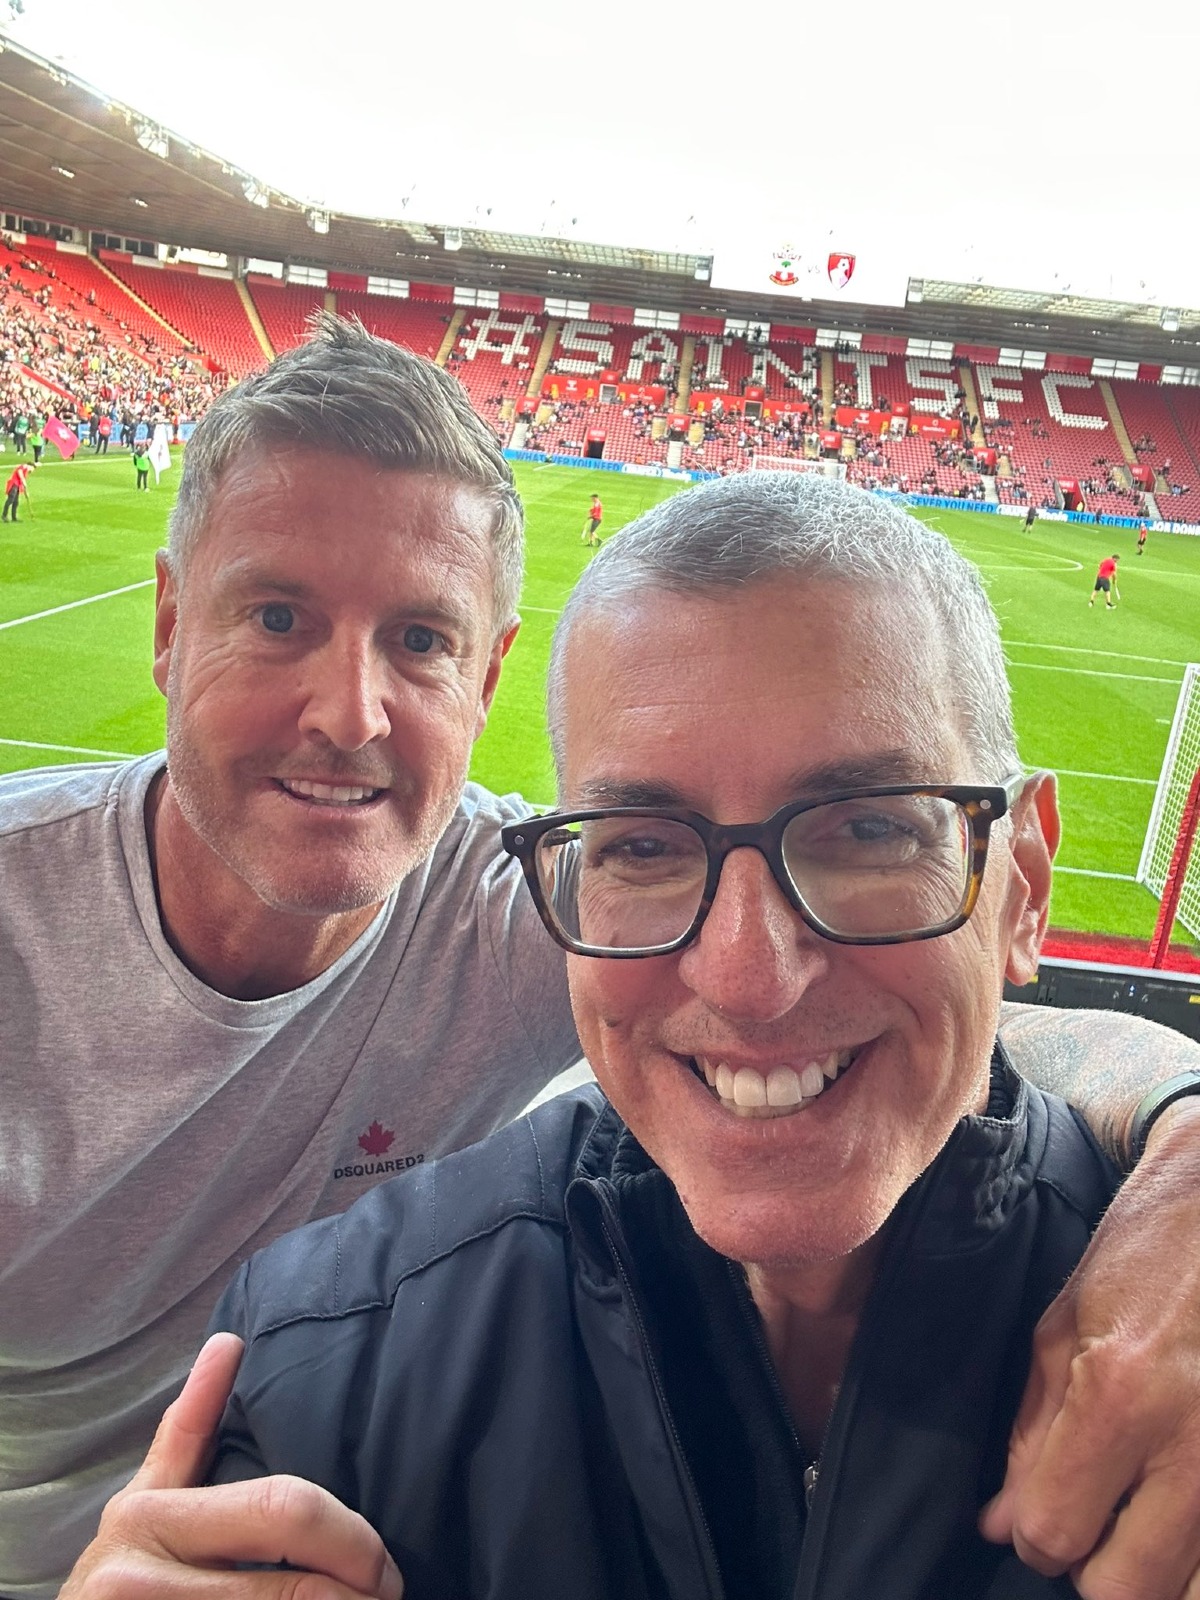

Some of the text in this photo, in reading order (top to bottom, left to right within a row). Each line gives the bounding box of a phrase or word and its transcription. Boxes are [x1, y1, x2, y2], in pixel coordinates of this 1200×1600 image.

[515, 451, 570, 466] WHATVER
[572, 458, 592, 469] YOU
[593, 461, 620, 472] NEED
[944, 500, 965, 509] YOU
[966, 503, 994, 512] NEED
[1106, 517, 1127, 527] GET
[1149, 520, 1171, 533] JOB
[333, 1153, 426, 1180] DSQUARED2
